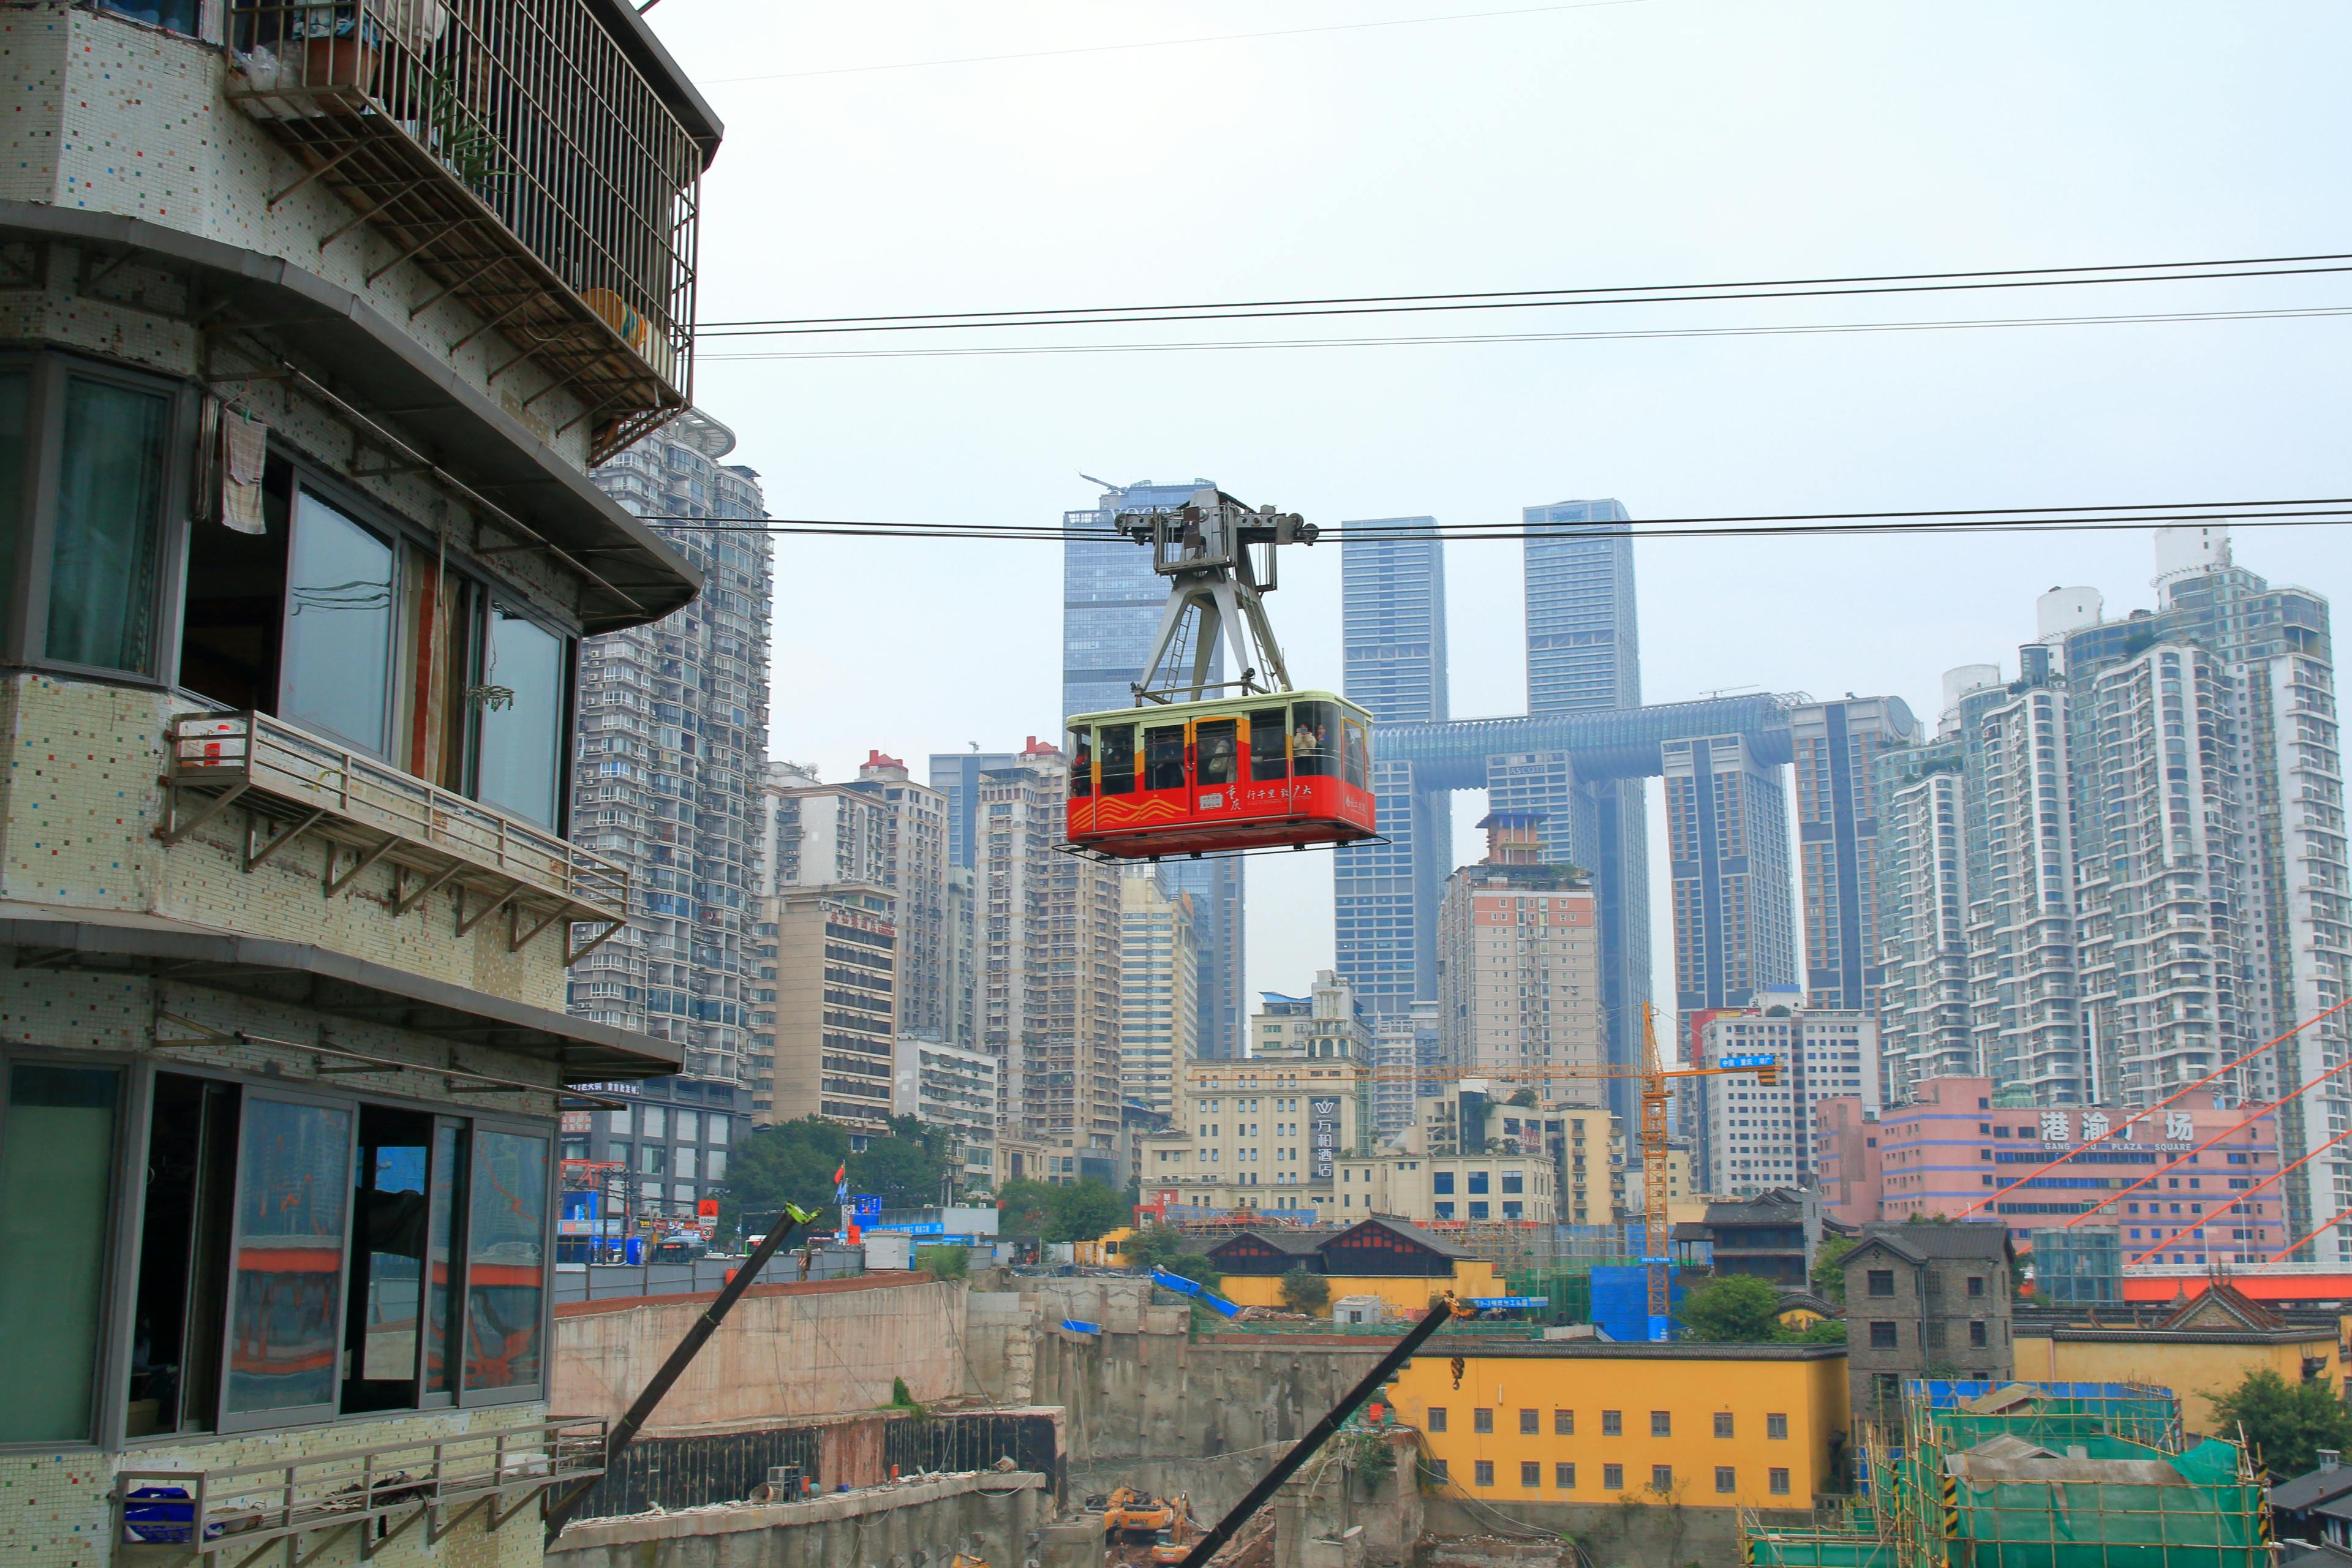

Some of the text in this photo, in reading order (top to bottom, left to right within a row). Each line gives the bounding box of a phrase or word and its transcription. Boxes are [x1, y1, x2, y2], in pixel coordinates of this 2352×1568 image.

[1226, 785, 1242, 812] 重庆
[1246, 789, 1275, 800] 行千里
[2040, 1112, 2194, 1141] 港渝广场
[1317, 1120, 1332, 1177] 万柏酒店
